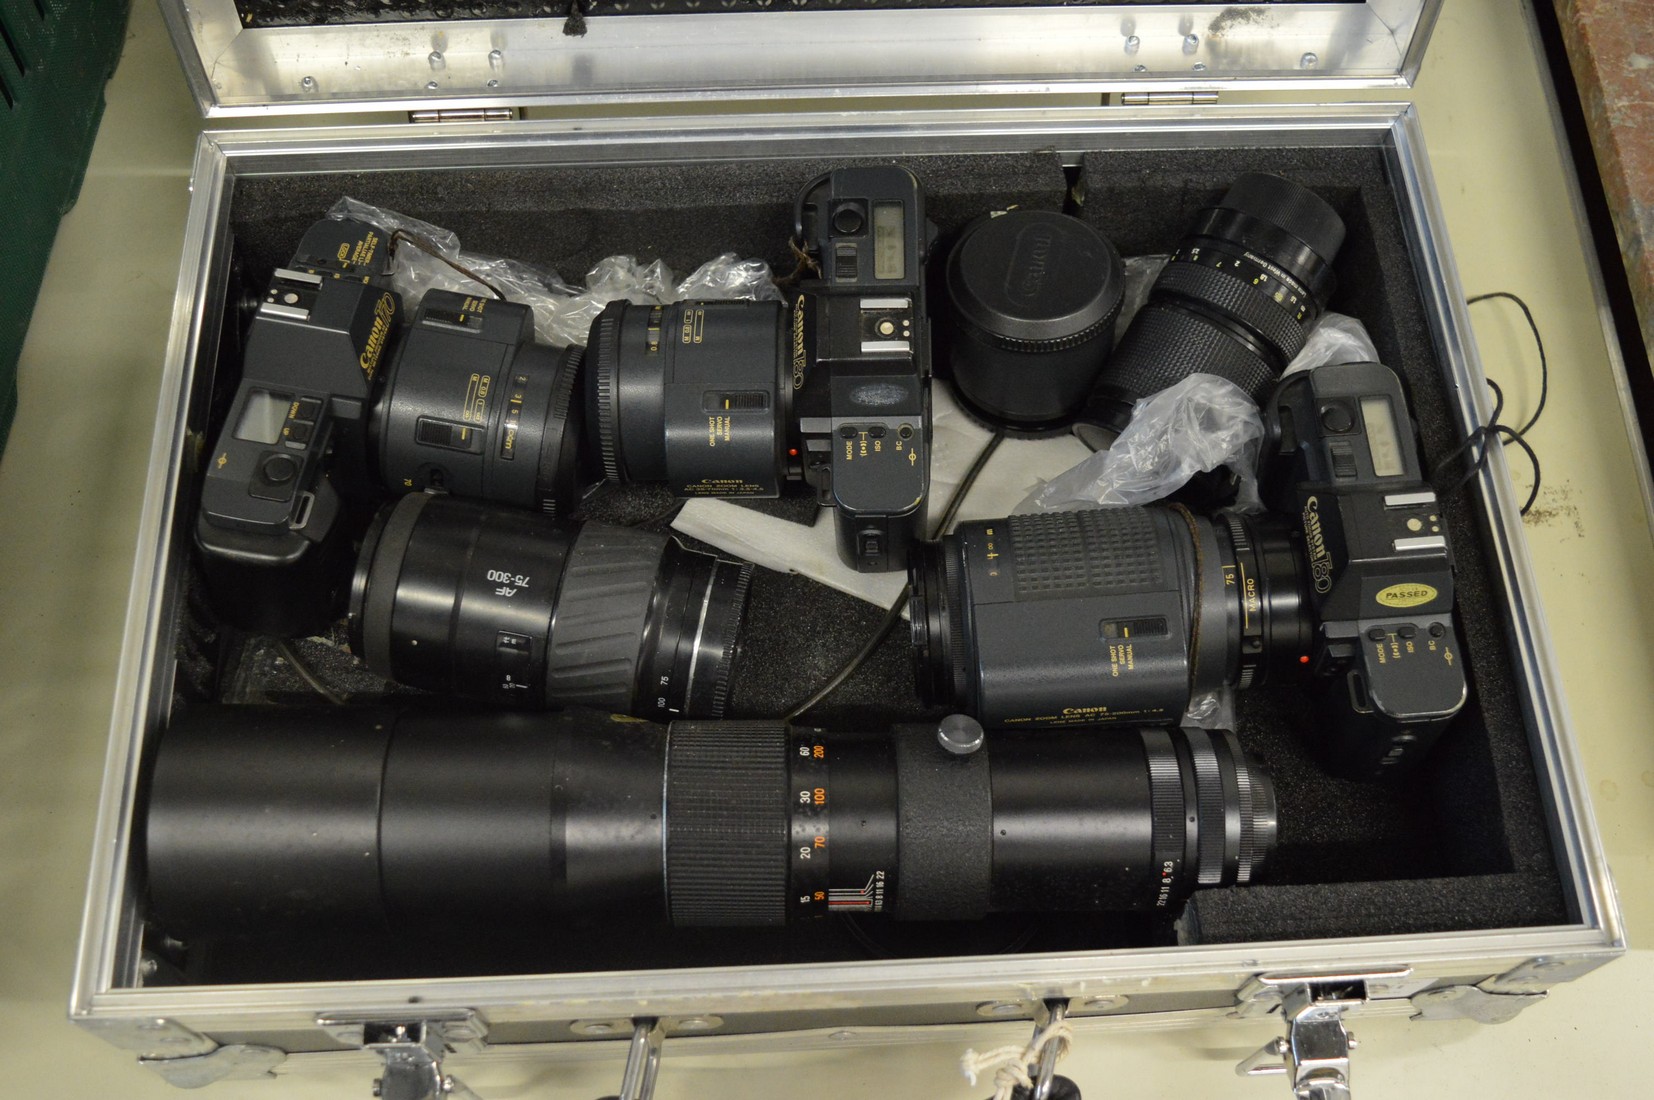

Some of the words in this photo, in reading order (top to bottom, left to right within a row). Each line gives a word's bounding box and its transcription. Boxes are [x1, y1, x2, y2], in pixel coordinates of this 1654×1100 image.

[360, 316, 383, 369] Canon
[288, 401, 300, 419] DOWN
[896, 440, 902, 451] BC
[1307, 496, 1326, 559] Canon
[487, 569, 530, 588] 75-300
[1225, 573, 1235, 585] 75
[1311, 551, 1333, 594] T80
[495, 586, 518, 597] AF
[1246, 578, 1257, 612] MACRO
[1386, 590, 1428, 599] PASSED
[1406, 641, 1414, 653] ISO
[1428, 640, 1437, 651] BC
[1109, 645, 1117, 662] SHOT
[1117, 644, 1126, 664] SERVO
[1126, 643, 1134, 670] MANUAL
[1376, 643, 1386, 664] MODE
[1111, 663, 1119, 677] ONE
[660, 675, 669, 685] 75
[1062, 706, 1107, 715] Canon
[800, 746, 810, 757] 60
[813, 745, 825, 758] 200
[800, 790, 810, 804] 30
[814, 788, 825, 805] 100
[814, 835, 825, 849] 70
[800, 846, 810, 859] 20
[876, 870, 885, 879] 22
[800, 895, 810, 904] 15
[814, 891, 824, 901] 50
